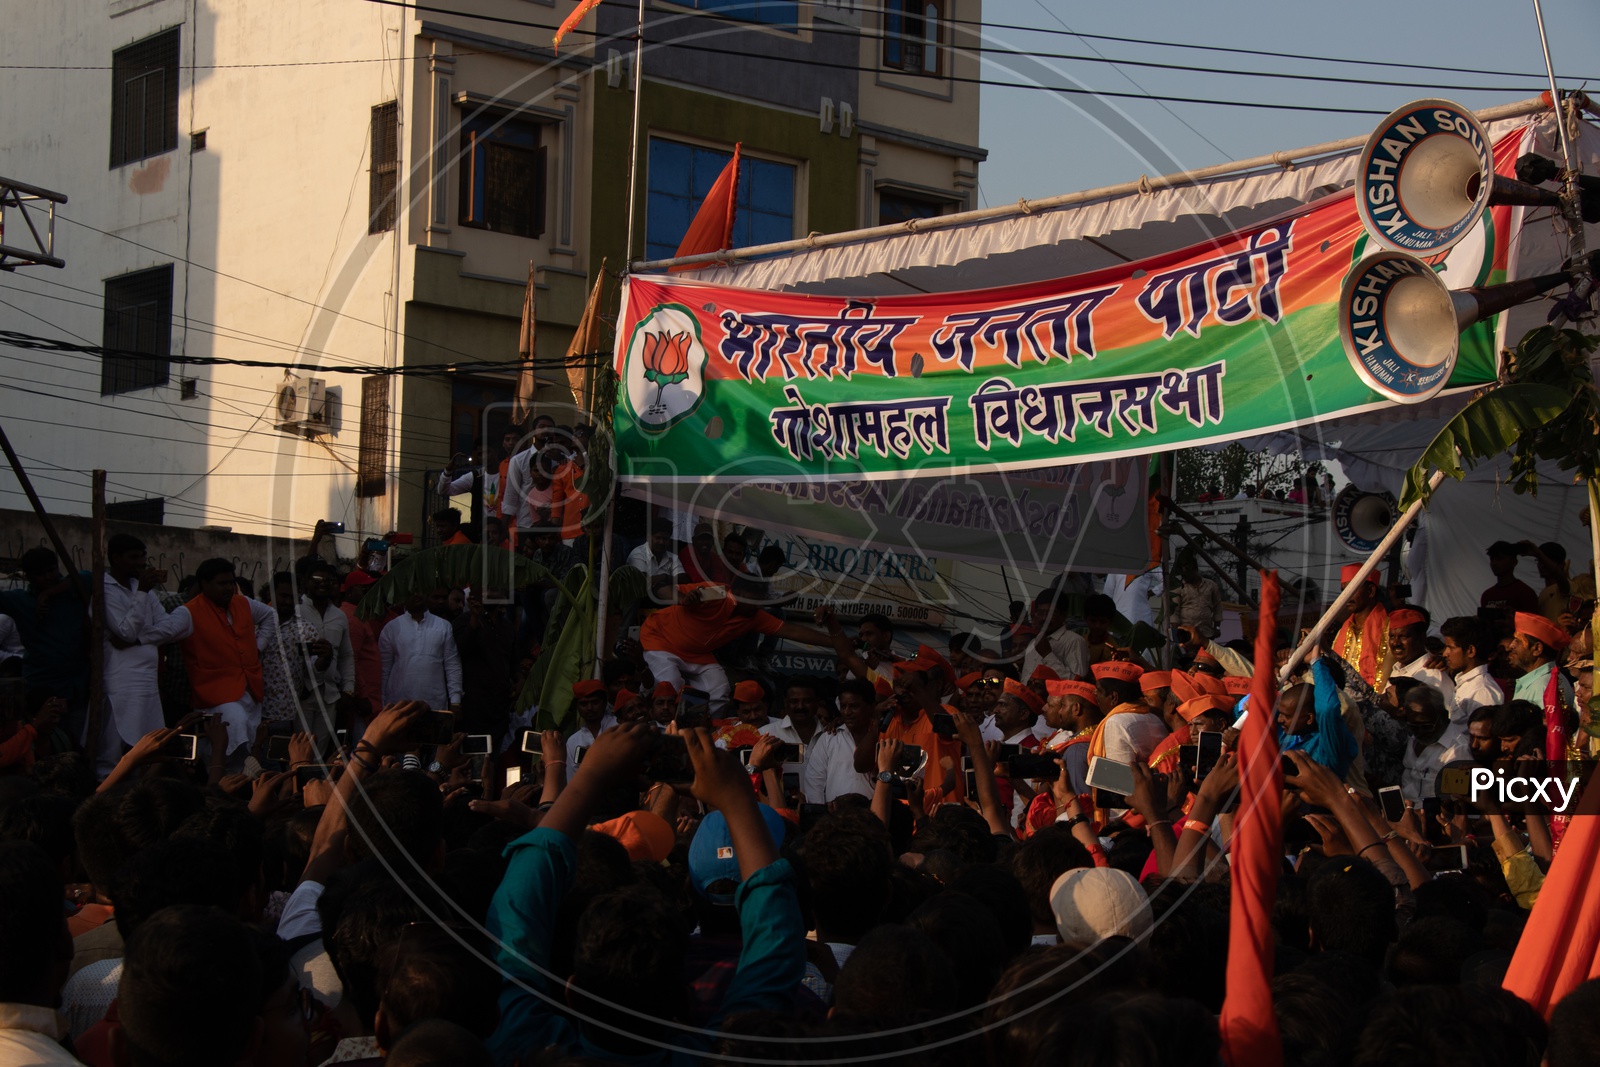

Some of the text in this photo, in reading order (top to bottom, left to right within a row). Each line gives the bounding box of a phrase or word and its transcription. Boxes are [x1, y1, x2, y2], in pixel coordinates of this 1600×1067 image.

[1368, 110, 1488, 235] KISHAN SOUND
[1392, 232, 1434, 249] HANUMAN
[1411, 229, 1433, 240] JALI
[1352, 260, 1417, 356] KISHAN
[718, 298, 924, 384] भारतीय
[929, 284, 1123, 374] जनता
[1364, 354, 1395, 385] HANUMAN
[1382, 358, 1401, 373] JALI
[769, 359, 1227, 462] गोशामहल विधानसभा
[806, 544, 938, 583] BROTHERS
[896, 605, 929, 620] 500006
